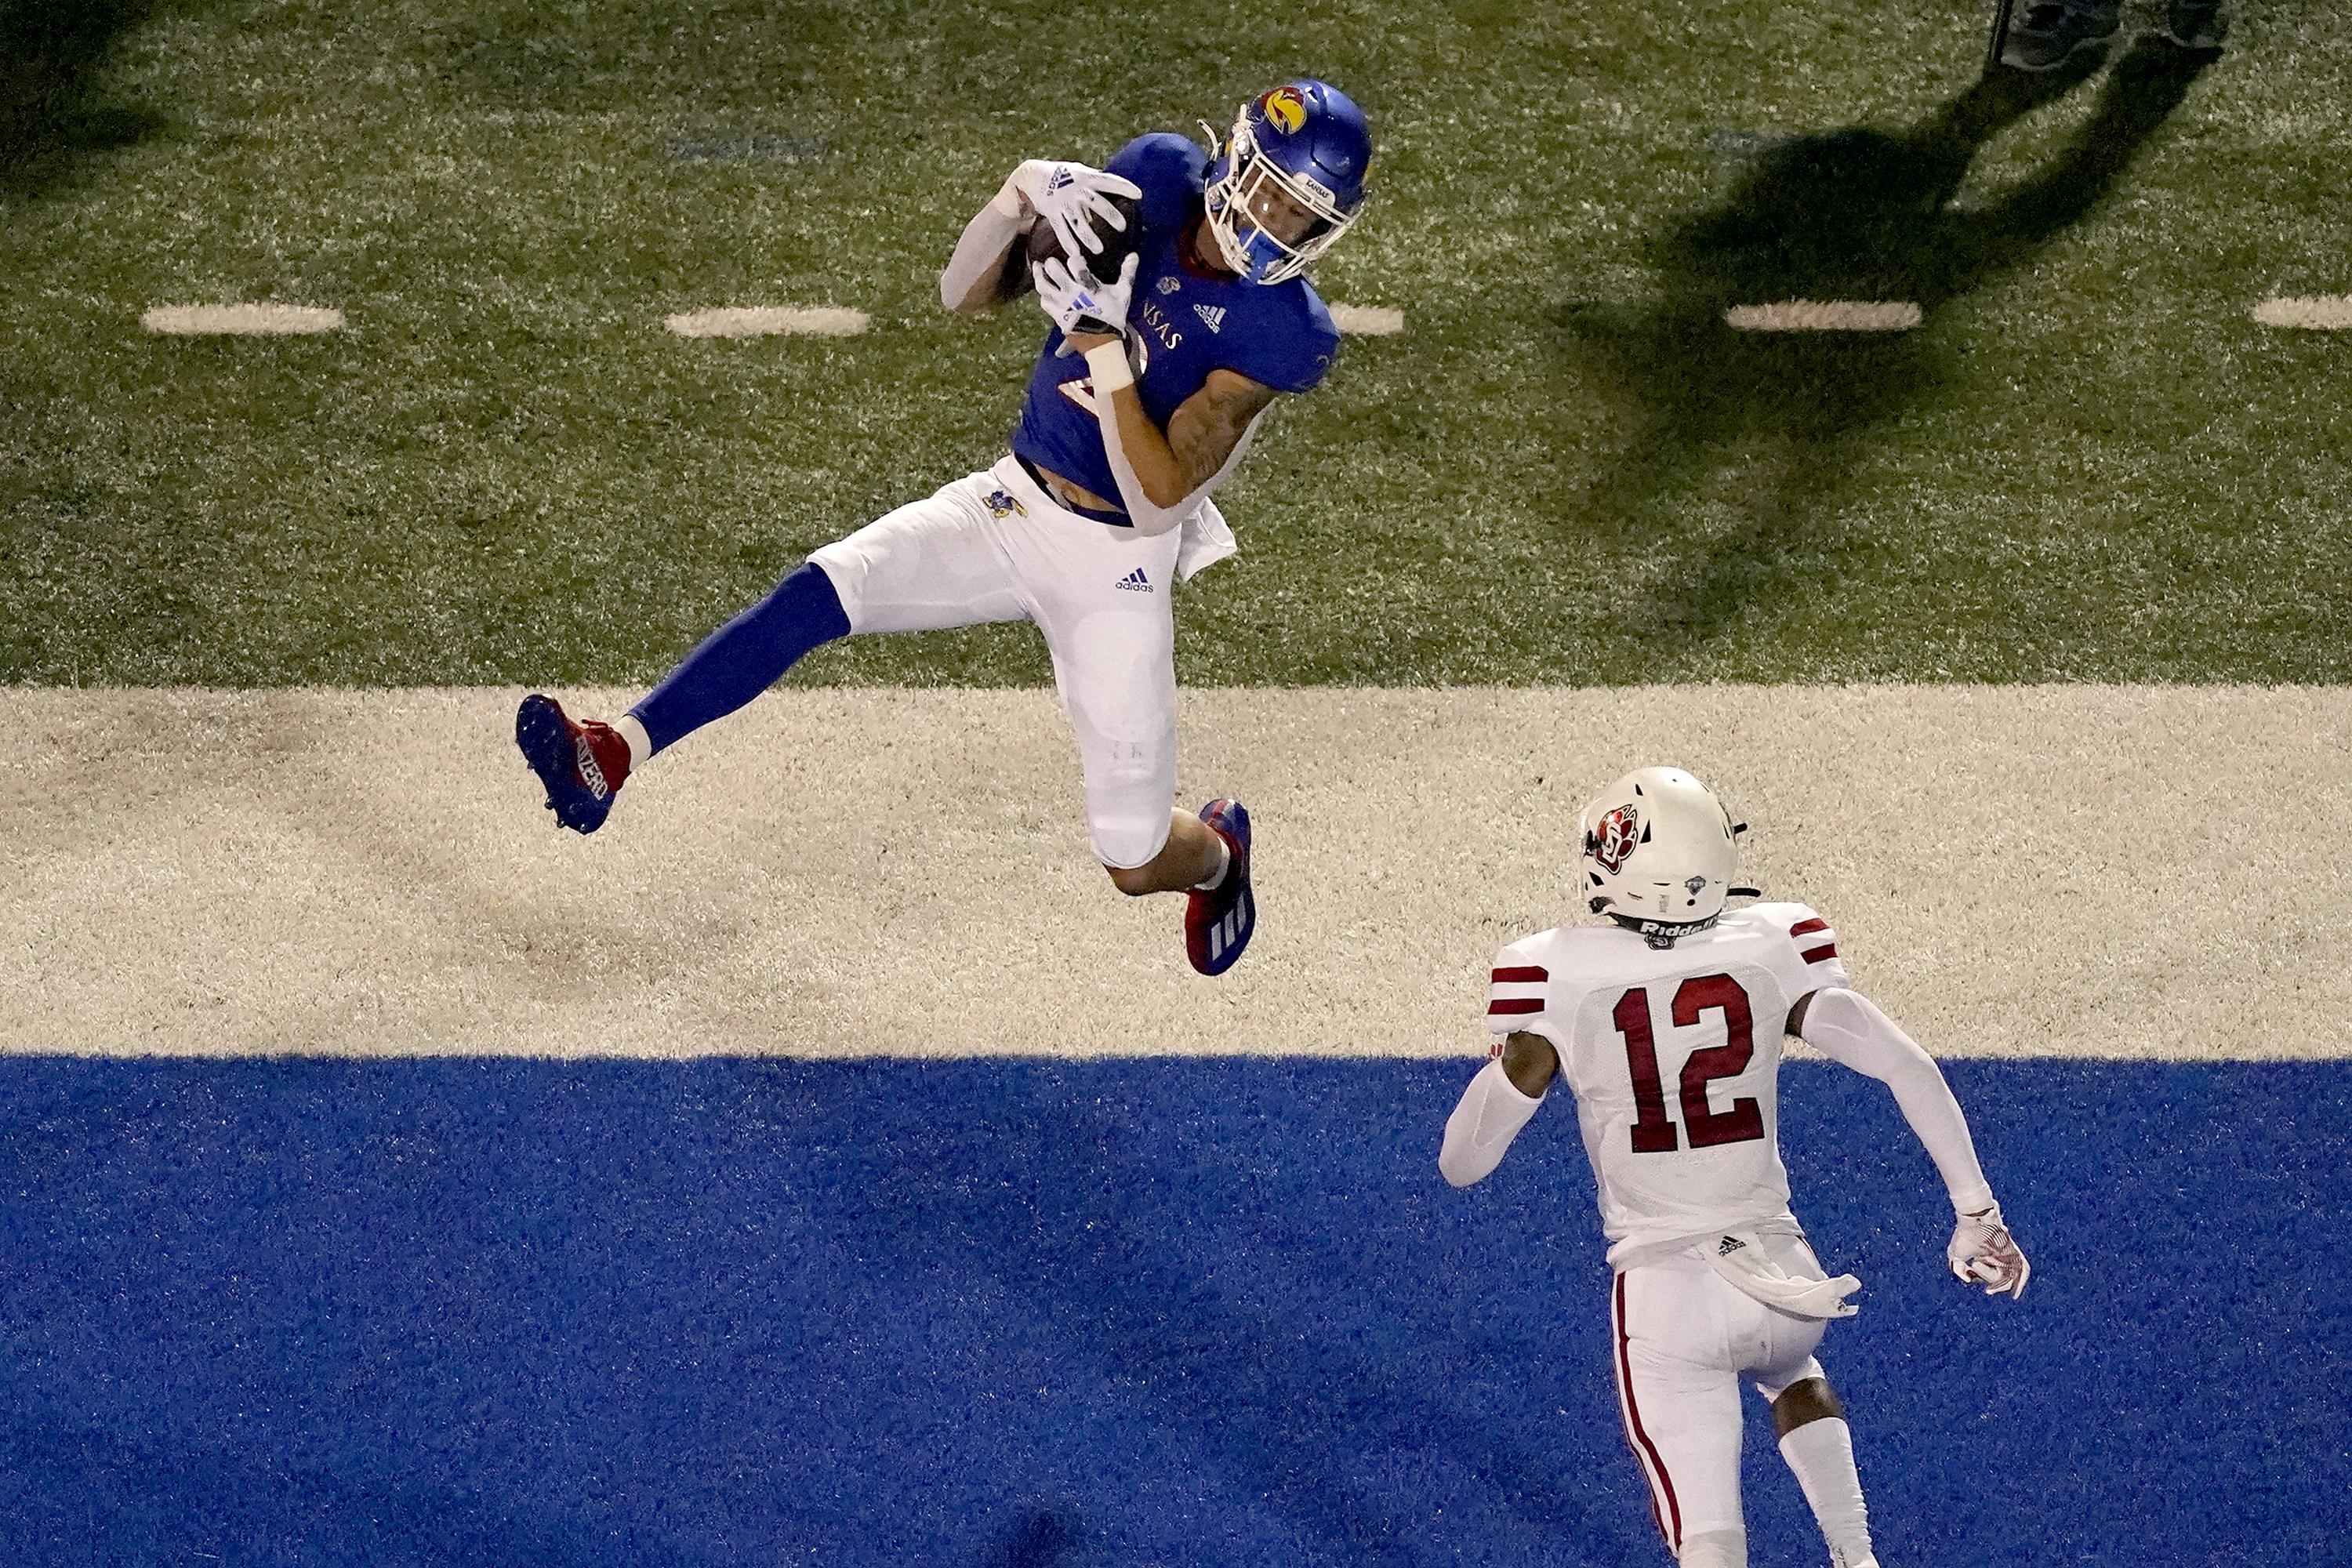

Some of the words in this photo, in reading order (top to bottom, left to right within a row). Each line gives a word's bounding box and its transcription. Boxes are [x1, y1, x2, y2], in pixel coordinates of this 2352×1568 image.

[1143, 299, 1182, 350] NSAS
[1192, 303, 1221, 334] adidas
[1115, 579, 1154, 593] adidas
[1640, 918, 1715, 937] Riddell
[1613, 972, 1766, 1153] 12
[1719, 1241, 1747, 1257] adidas
